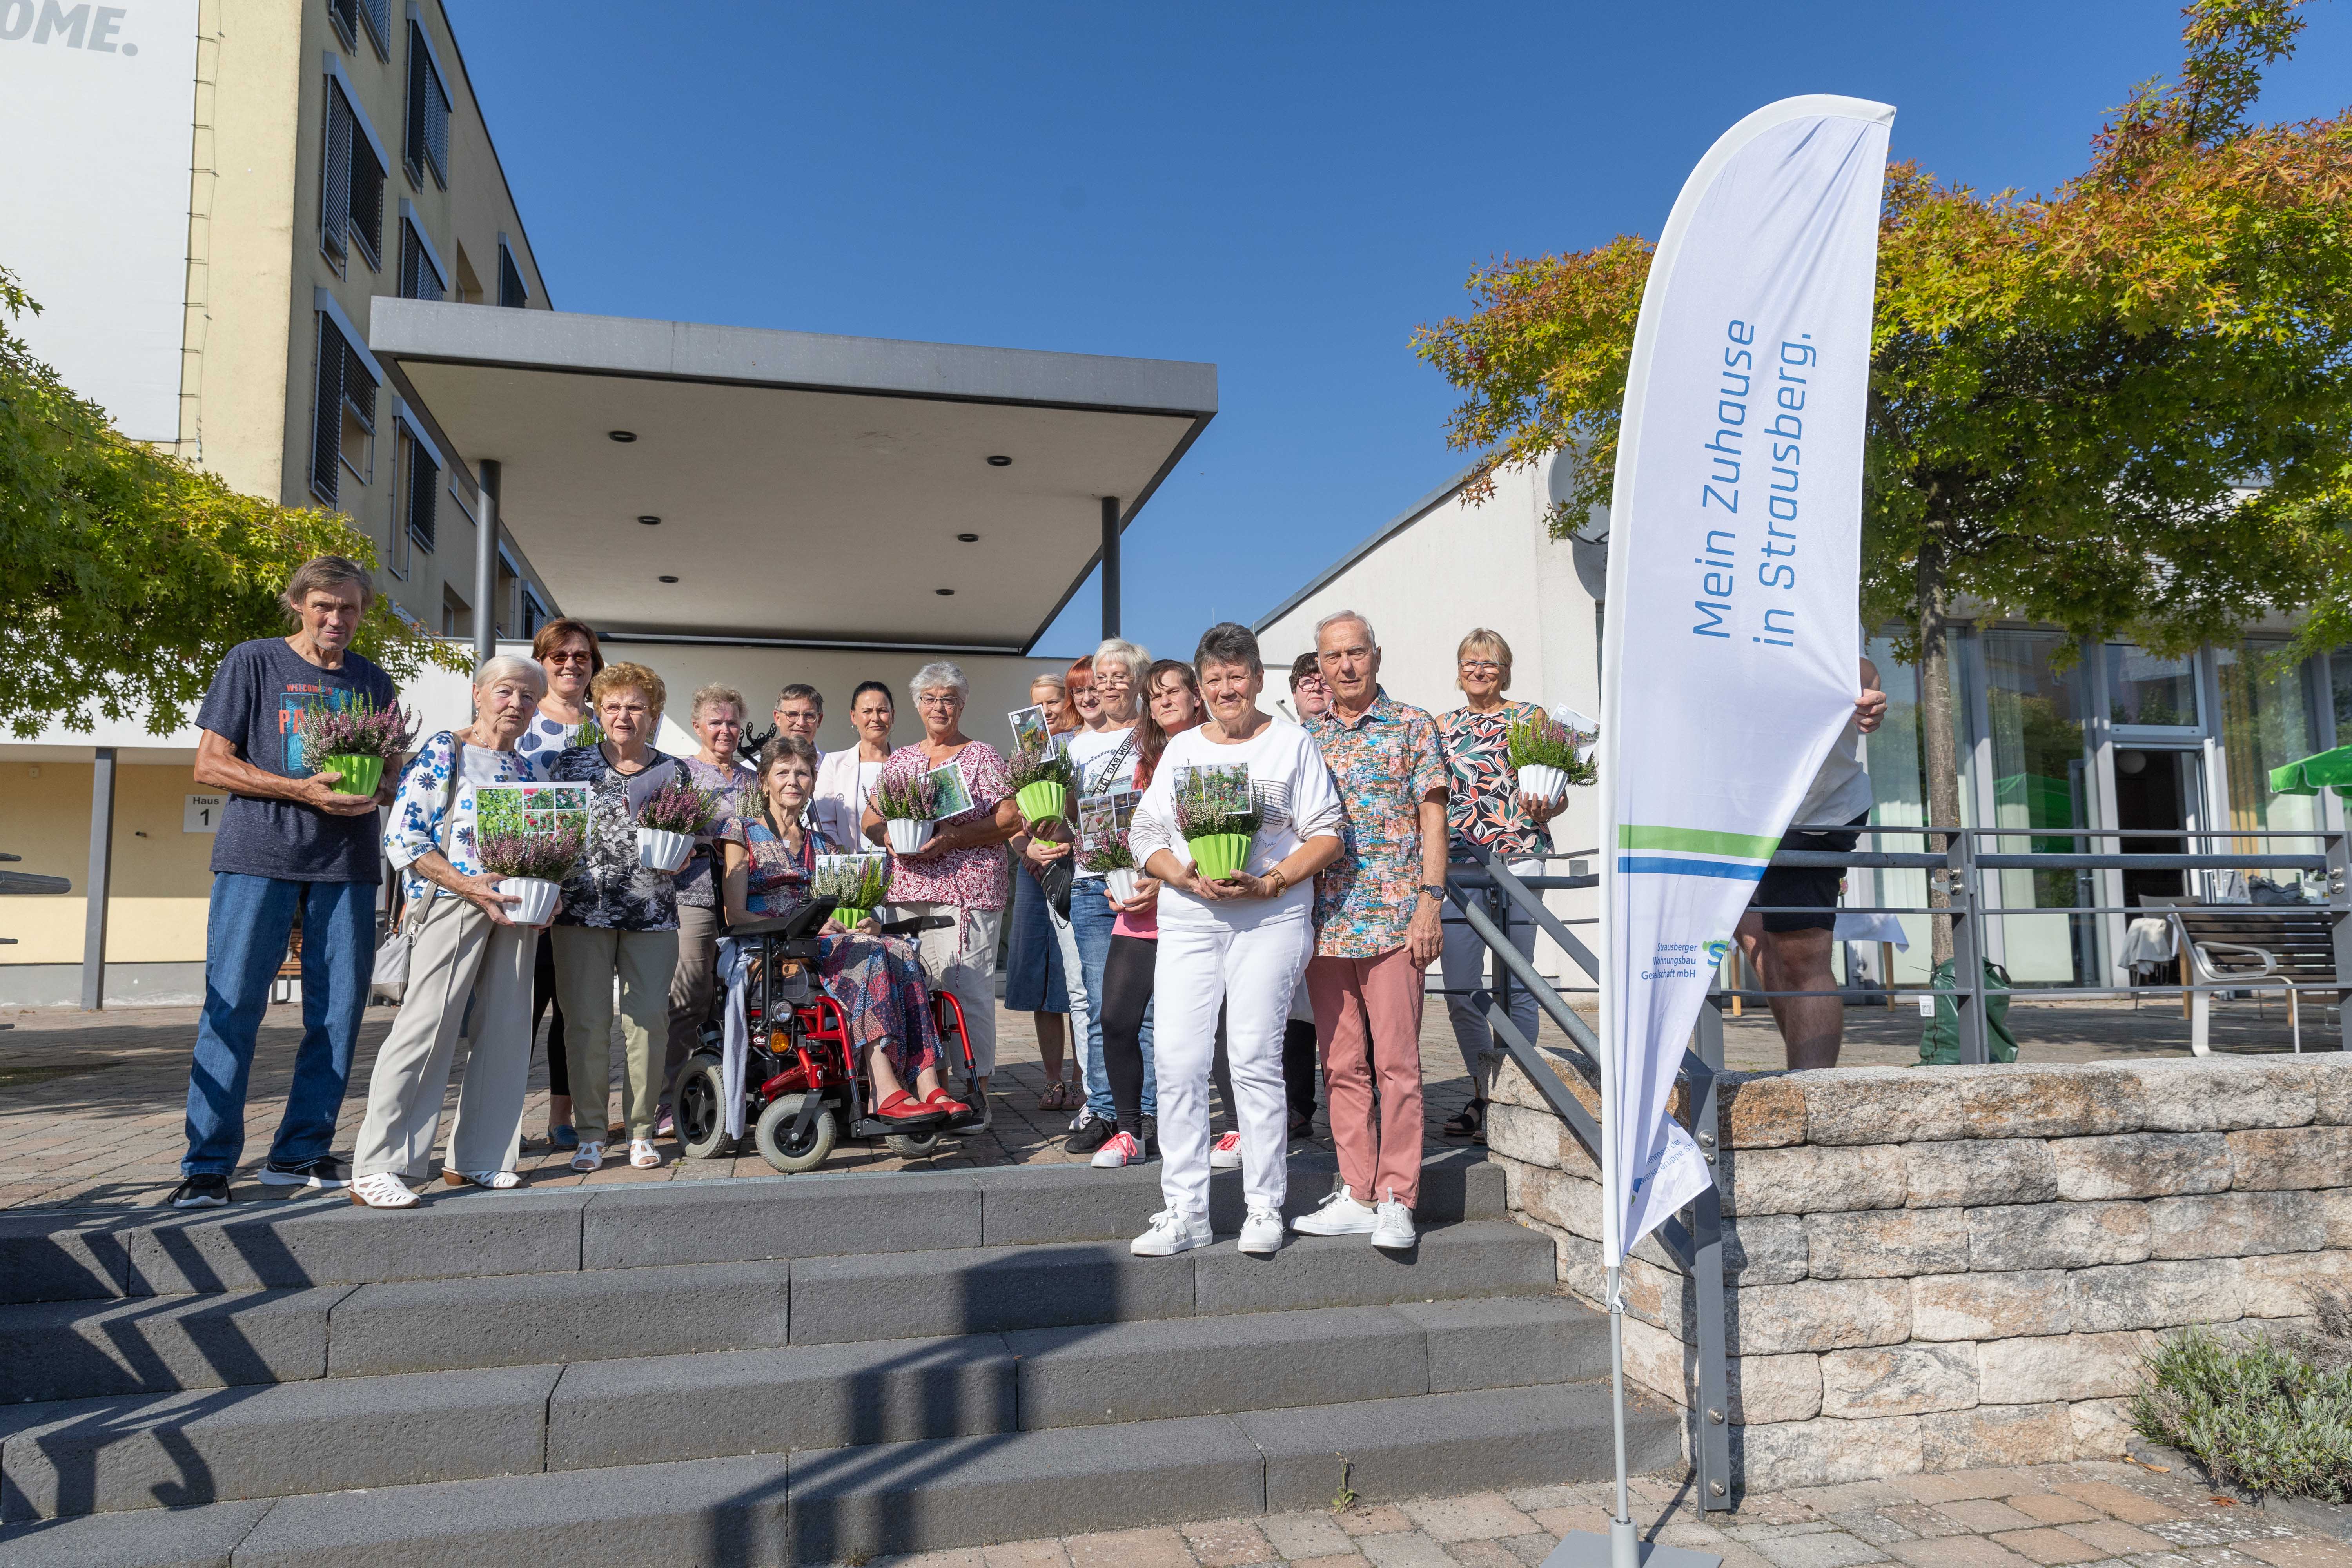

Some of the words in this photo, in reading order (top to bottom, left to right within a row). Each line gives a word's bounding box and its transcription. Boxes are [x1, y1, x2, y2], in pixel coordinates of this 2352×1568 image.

[1702, 319, 1755, 513] Zuhause
[1758, 334, 1817, 590] Strausberg.
[1693, 529, 1735, 639] Mein
[1753, 609, 1795, 647] in
[286, 684, 321, 693] WELCOM
[193, 797, 220, 805] Haus
[200, 809, 209, 826] 1
[1657, 942, 1698, 953] Strausberger
[1653, 955, 1696, 966] Wohnungsbau
[1641, 969, 1675, 980] Gesellschaft
[1677, 969, 1696, 978] mbH
[1670, 1139, 1681, 1148] der
[1640, 1168, 1660, 1185] werke
[1659, 1151, 1684, 1170] Gruppe
